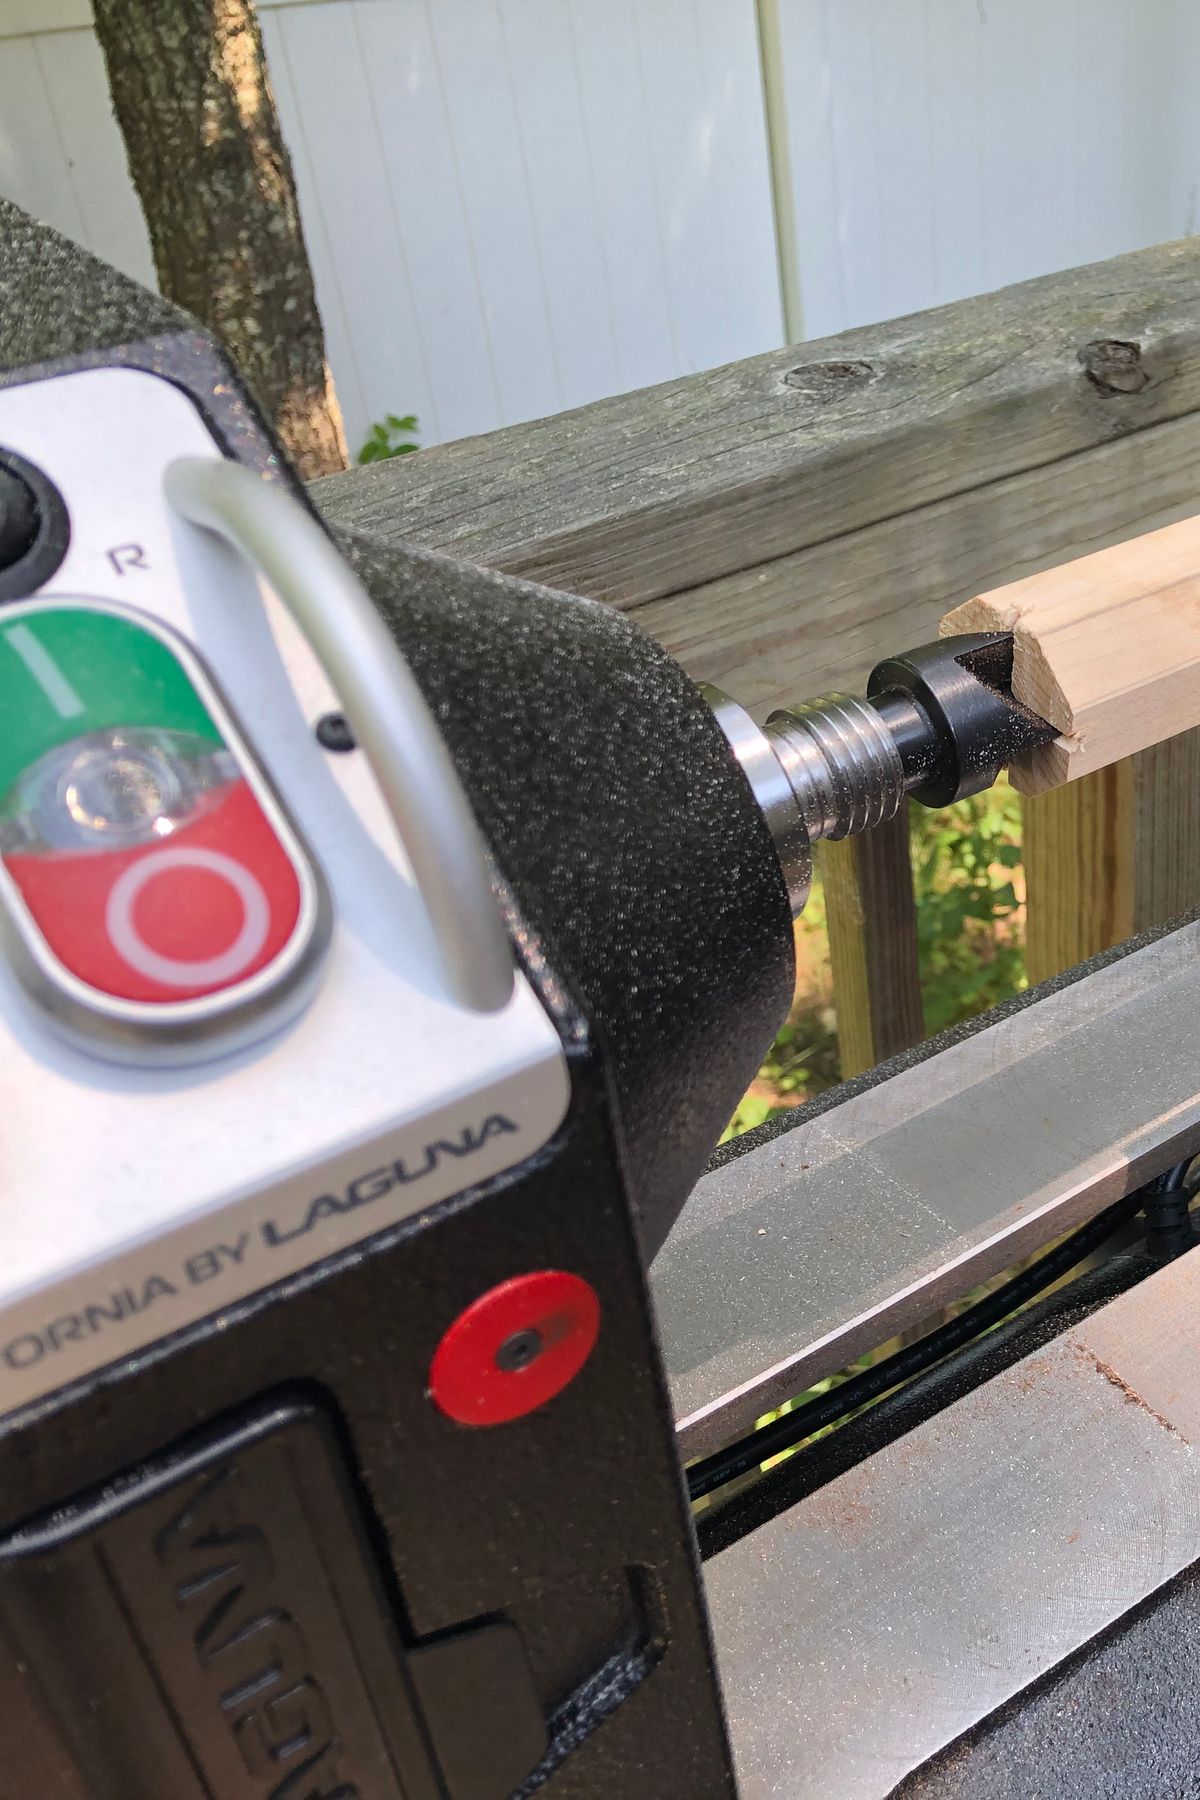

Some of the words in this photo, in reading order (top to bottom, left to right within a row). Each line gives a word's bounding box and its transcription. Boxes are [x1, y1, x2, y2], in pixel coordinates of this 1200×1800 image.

[106, 543, 151, 577] R
[184, 1231, 249, 1288] BY
[258, 1111, 521, 1249] LAGUNA
